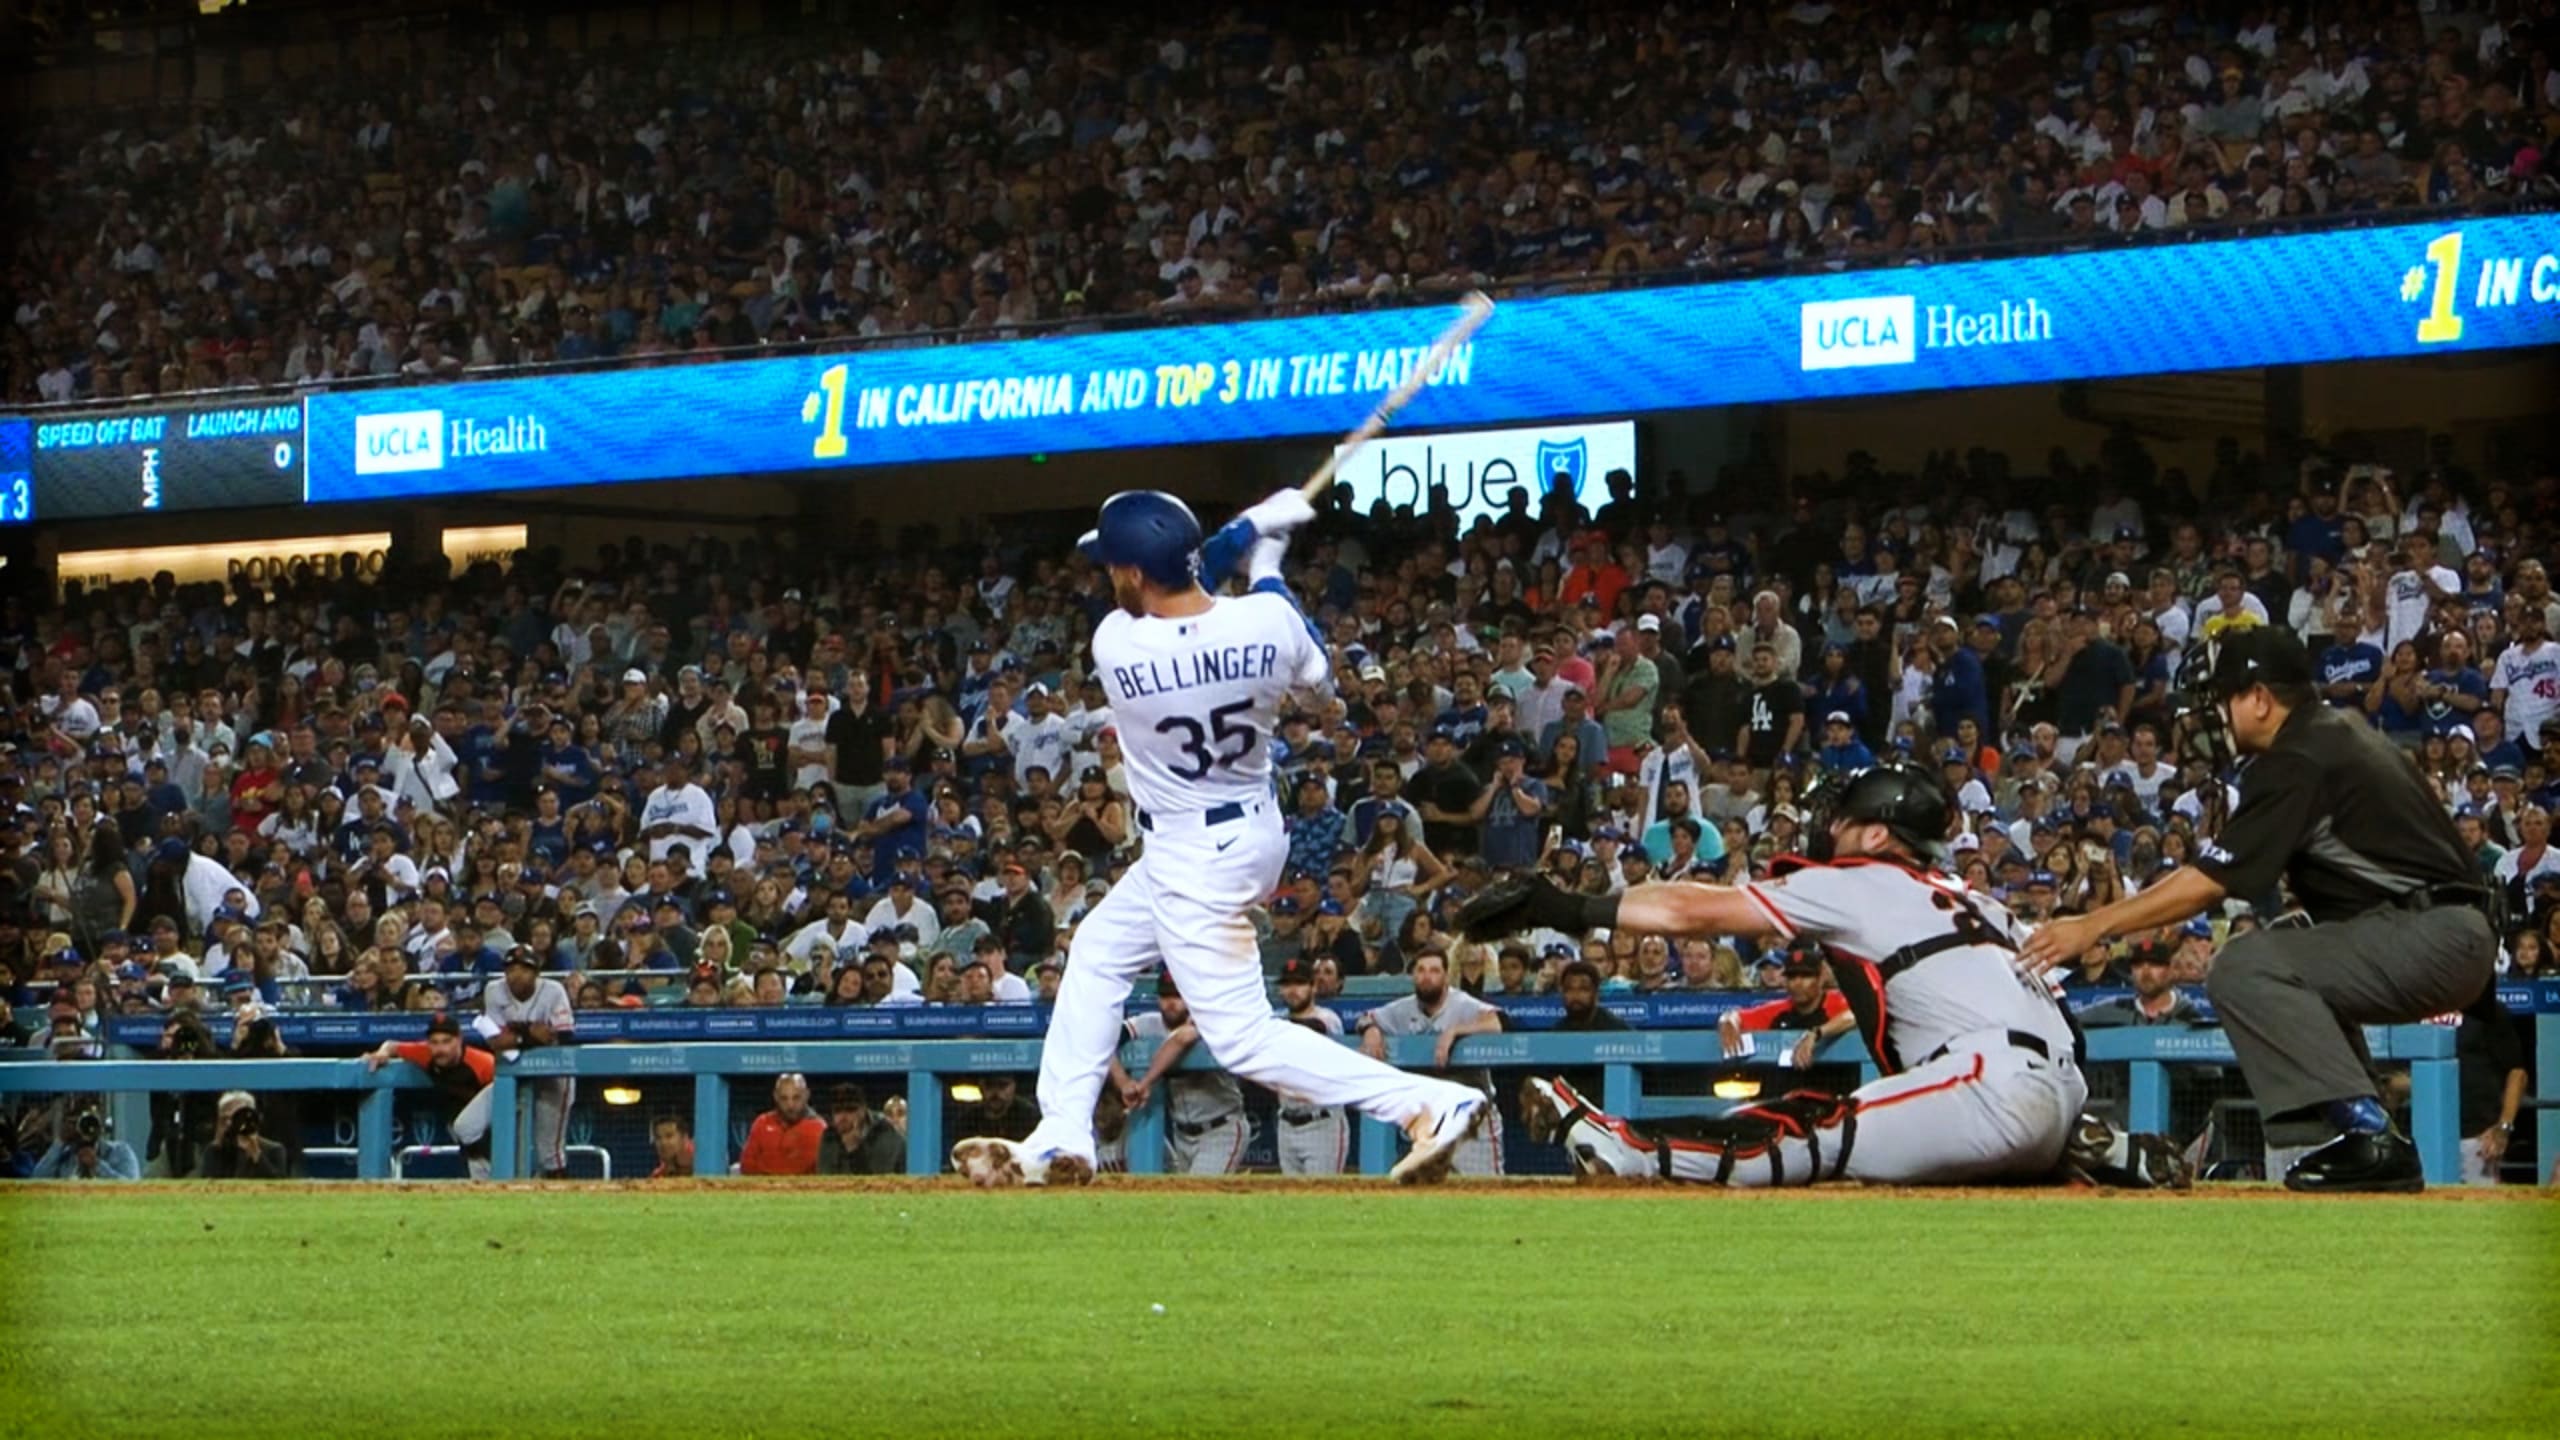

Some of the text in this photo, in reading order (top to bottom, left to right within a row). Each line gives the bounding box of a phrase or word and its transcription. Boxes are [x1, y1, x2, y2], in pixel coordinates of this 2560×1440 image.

[2401, 231, 2560, 343] #1 IN C
[1817, 298, 2053, 350] UCLA Health
[187, 406, 299, 438] LAUNCH ANG
[801, 363, 848, 459] #1
[856, 386, 891, 428] IN
[895, 373, 1073, 426] CALIFORNIA
[1080, 368, 1147, 414] AND
[1155, 364, 1215, 408] TOP
[1219, 360, 1241, 404] 3
[1245, 357, 1283, 400] IN
[1290, 352, 1349, 396] THE
[37, 416, 166, 449] SPEED OFF BAT
[274, 442, 291, 468] 0
[368, 415, 546, 457] UCLA Health
[13, 479, 28, 519] 3
[142, 448, 159, 508] MPH
[1382, 445, 1518, 512] blue
[1114, 644, 1277, 699] BELLINGER
[1752, 693, 1773, 731] LA
[1155, 697, 1256, 781] 35
